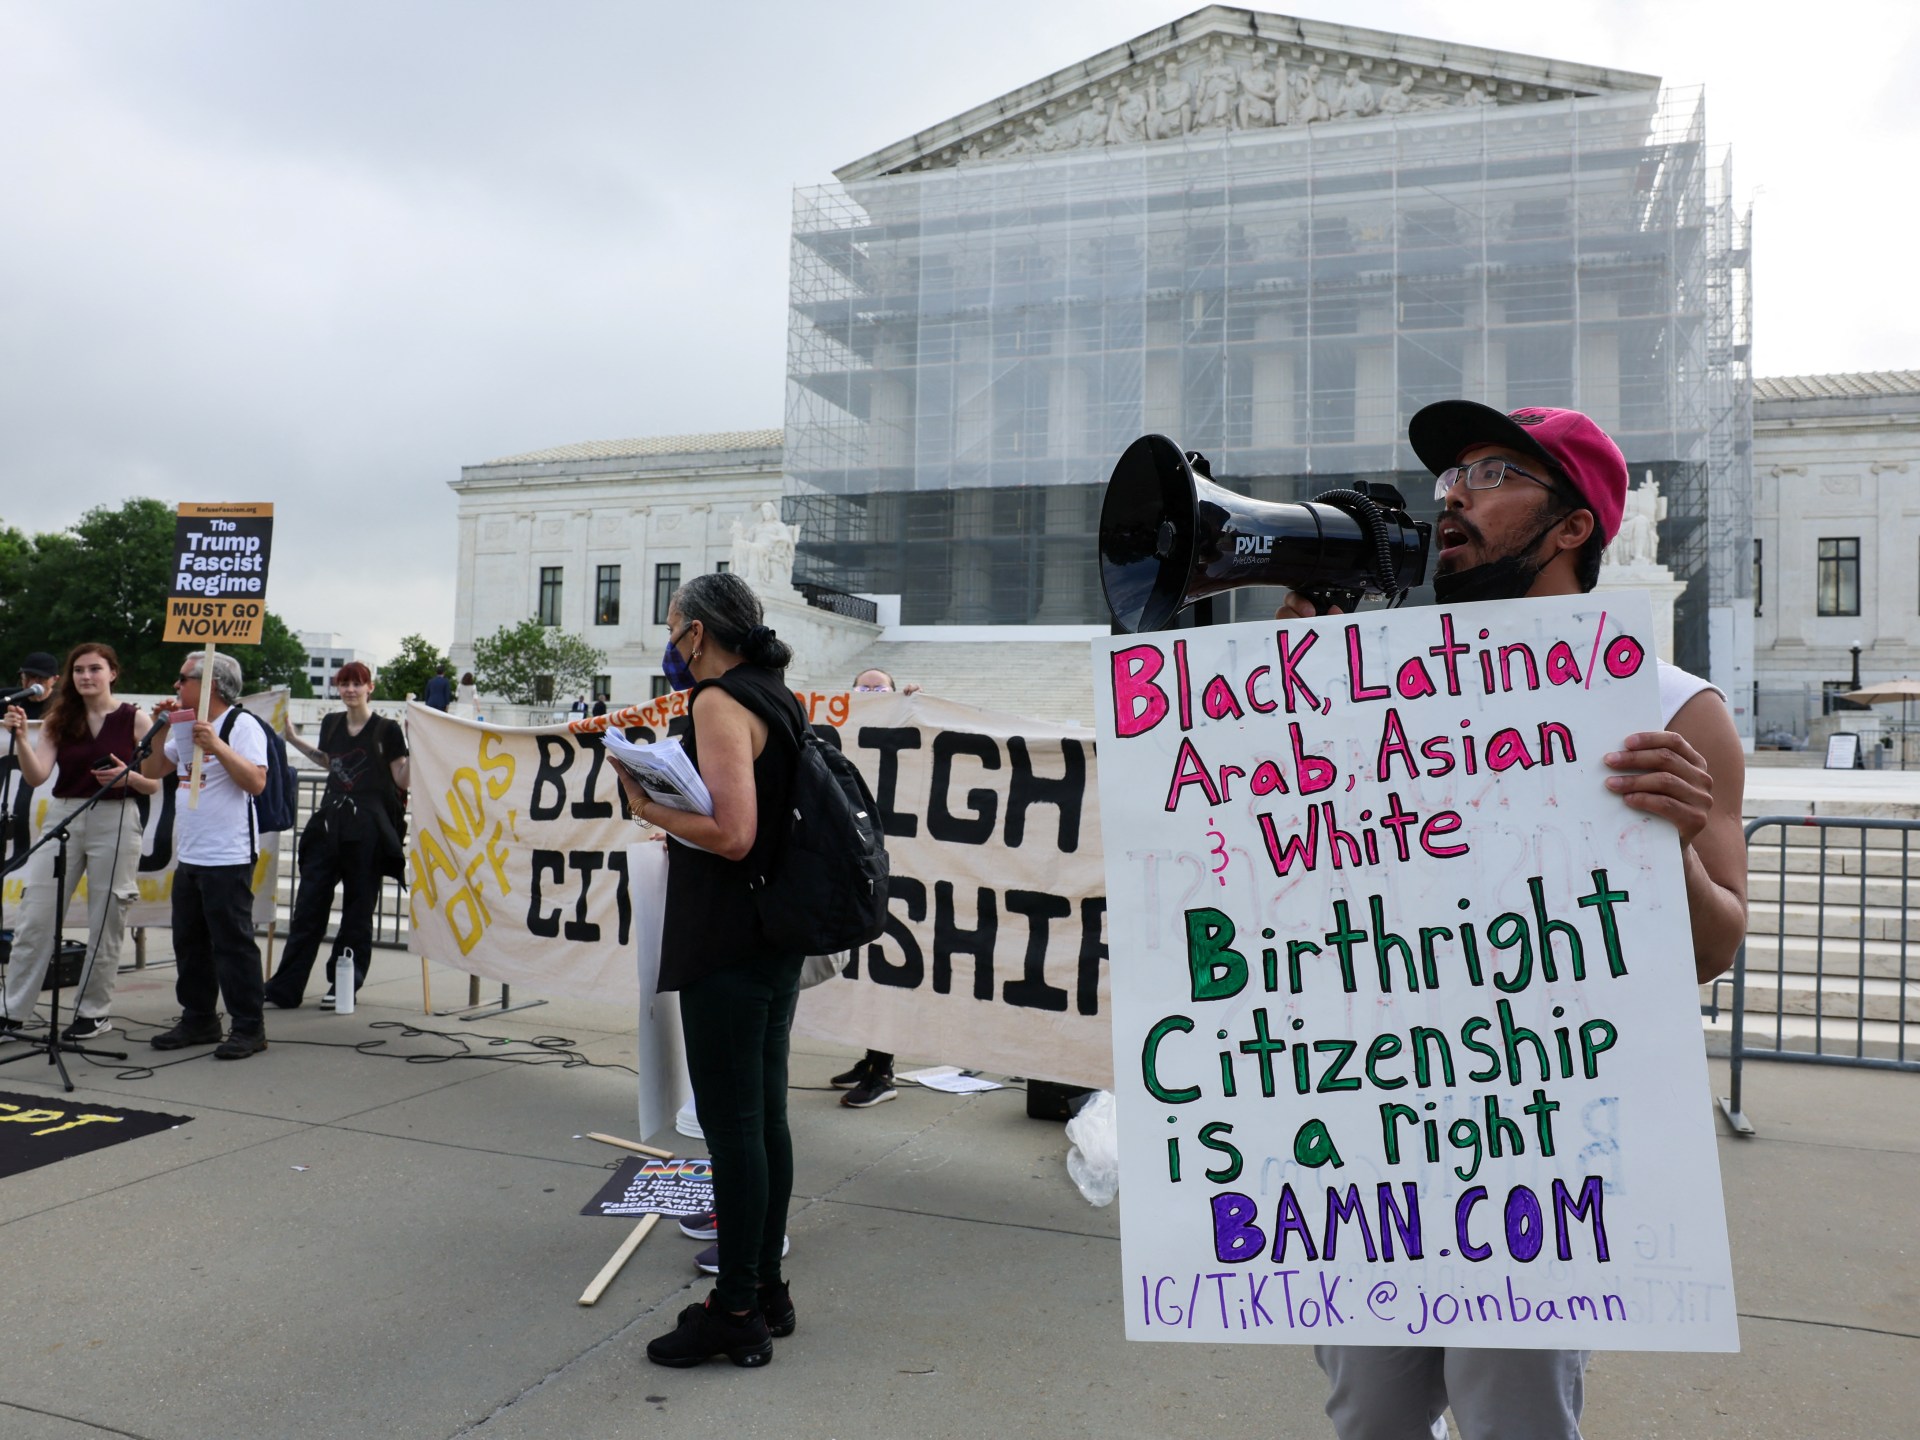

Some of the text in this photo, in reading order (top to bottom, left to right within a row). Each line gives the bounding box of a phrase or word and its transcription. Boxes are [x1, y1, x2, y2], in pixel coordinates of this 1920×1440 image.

[210, 519, 237, 532] The
[187, 533, 260, 556] Trump
[1235, 536, 1273, 554] PYLE
[179, 553, 263, 571] Fascist
[176, 573, 261, 596] Regime
[172, 603, 259, 617] MUST GO
[177, 619, 252, 636] NOW!!!
[1346, 611, 1644, 702] Latina/o
[1165, 709, 1577, 812] Arab, Asian
[410, 730, 516, 930] HANDS
[1257, 793, 1470, 876] White
[1184, 869, 1629, 1002] Birthright
[1141, 999, 1618, 1103] Citizenship
[1167, 1089, 1560, 1184] is a right
[634, 1160, 713, 1181] NO
[642, 1195, 698, 1205] Accept
[1210, 1175, 1611, 1264] BAMN.COM
